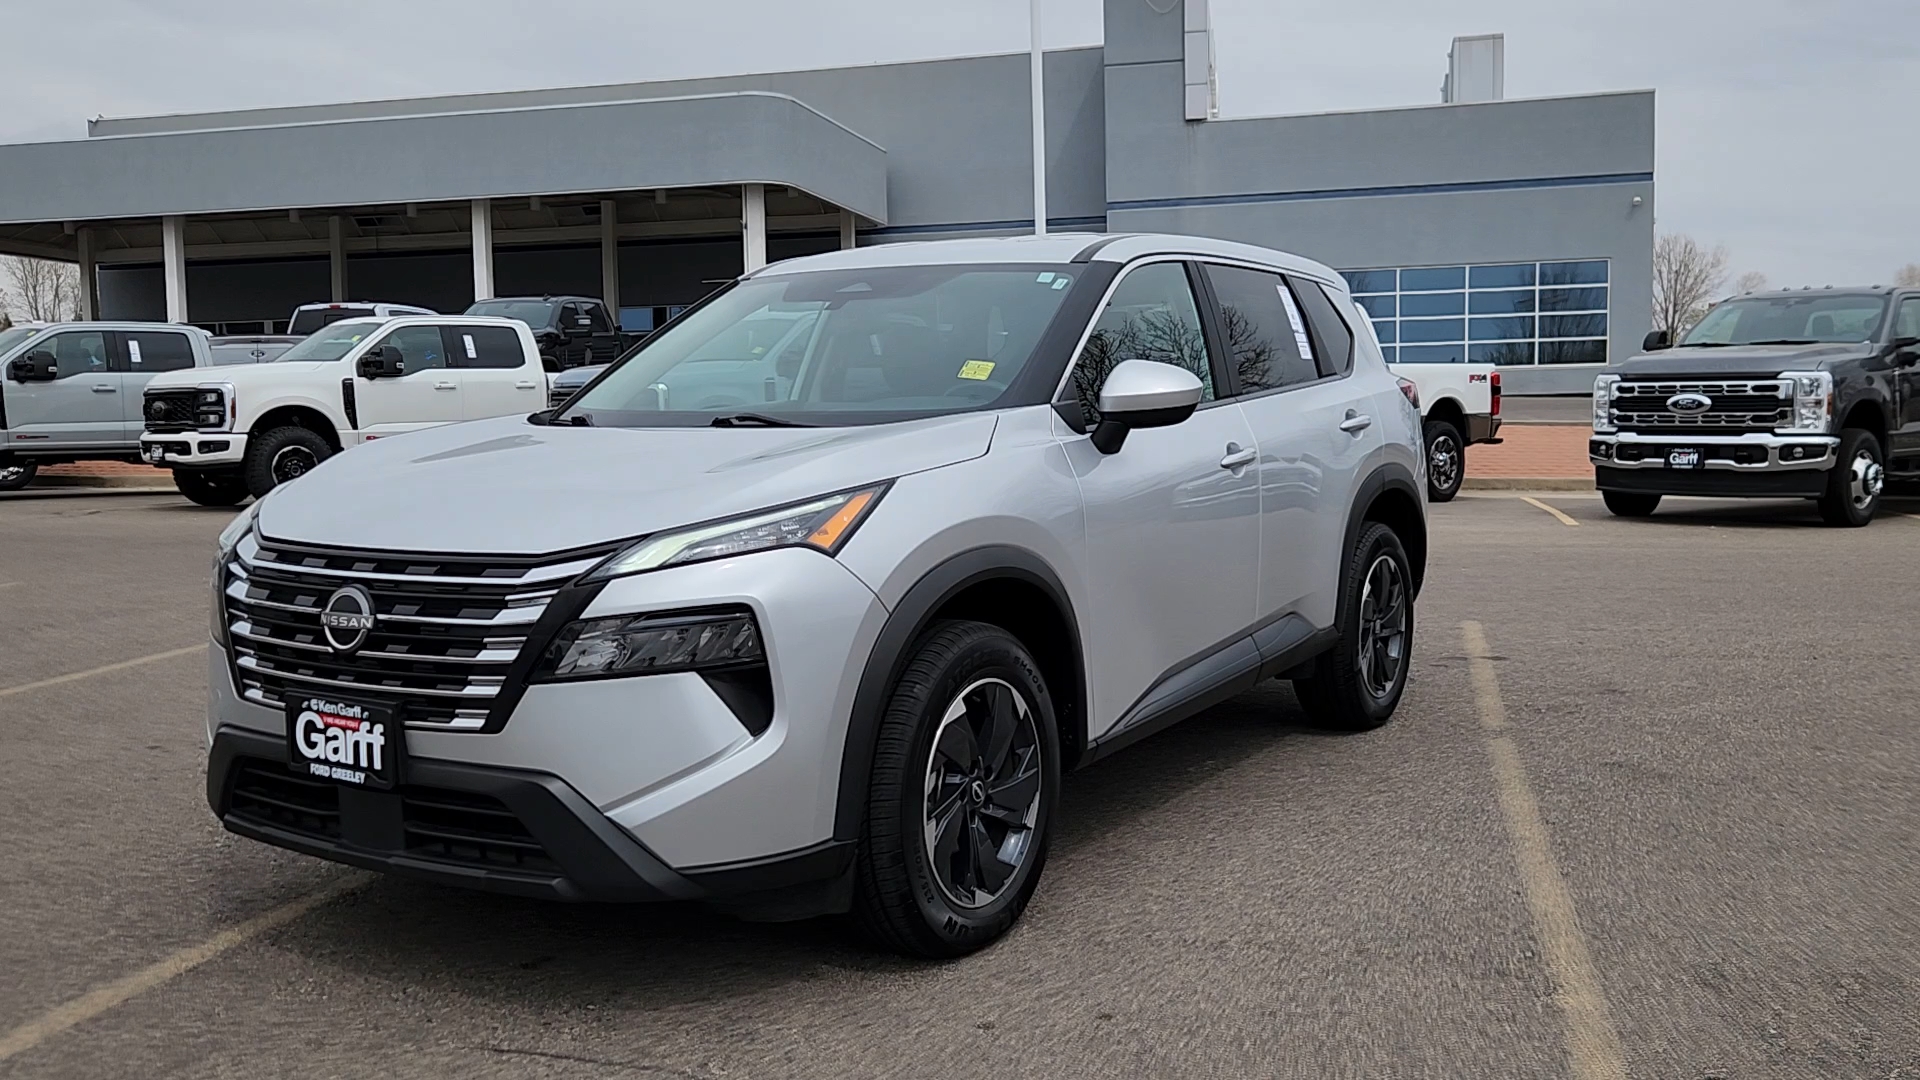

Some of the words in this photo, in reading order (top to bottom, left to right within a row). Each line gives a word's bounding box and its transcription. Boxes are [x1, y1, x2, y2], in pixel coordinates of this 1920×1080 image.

[1669, 452, 1699, 465] Garff
[320, 613, 372, 628] NISSAN
[319, 699, 337, 715] Ken
[337, 703, 361, 718] Garff
[295, 711, 385, 770] Garff
[310, 763, 331, 777] FORD
